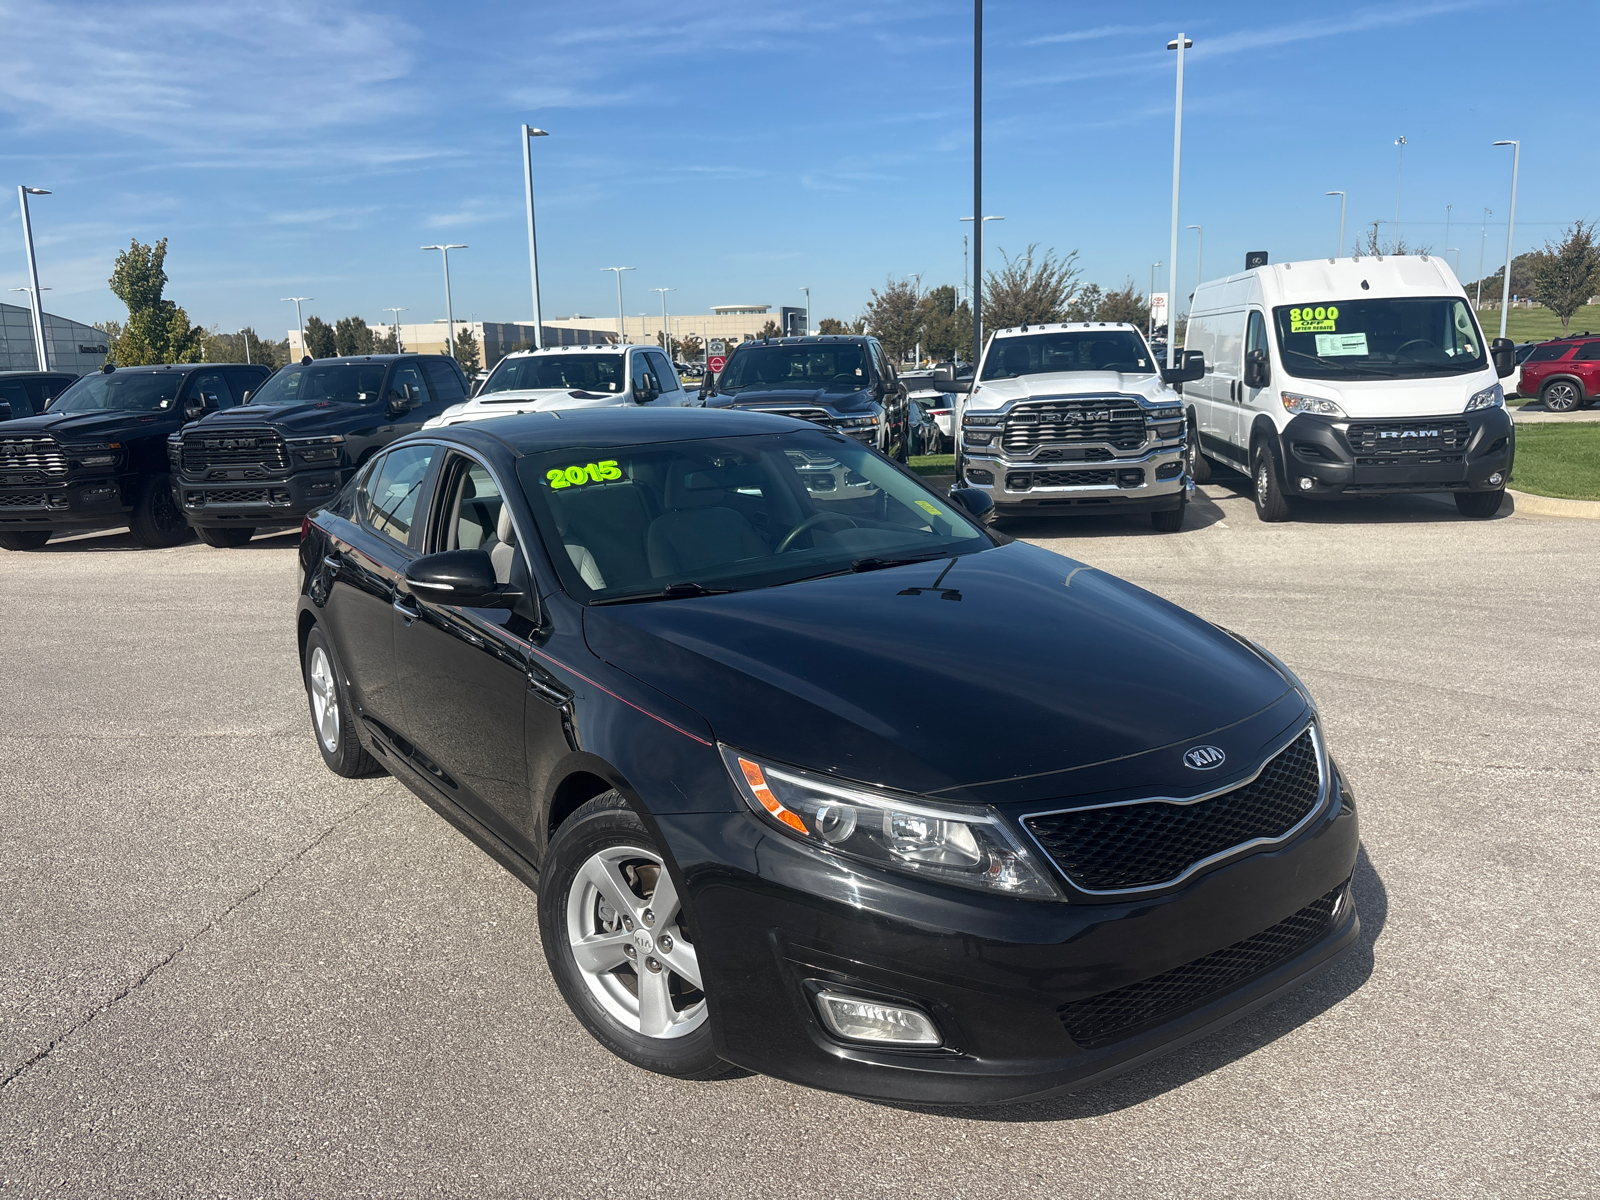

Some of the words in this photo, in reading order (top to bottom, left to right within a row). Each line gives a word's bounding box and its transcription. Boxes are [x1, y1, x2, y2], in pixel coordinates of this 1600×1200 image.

[1290, 306, 1339, 321] 8000
[1040, 411, 1109, 423] RAM
[1380, 430, 1439, 439] RAM
[0, 443, 33, 454] AM
[203, 438, 257, 449] RAM
[546, 460, 622, 489] 2015
[1187, 747, 1223, 767] KIA
[635, 936, 651, 948] KIA
